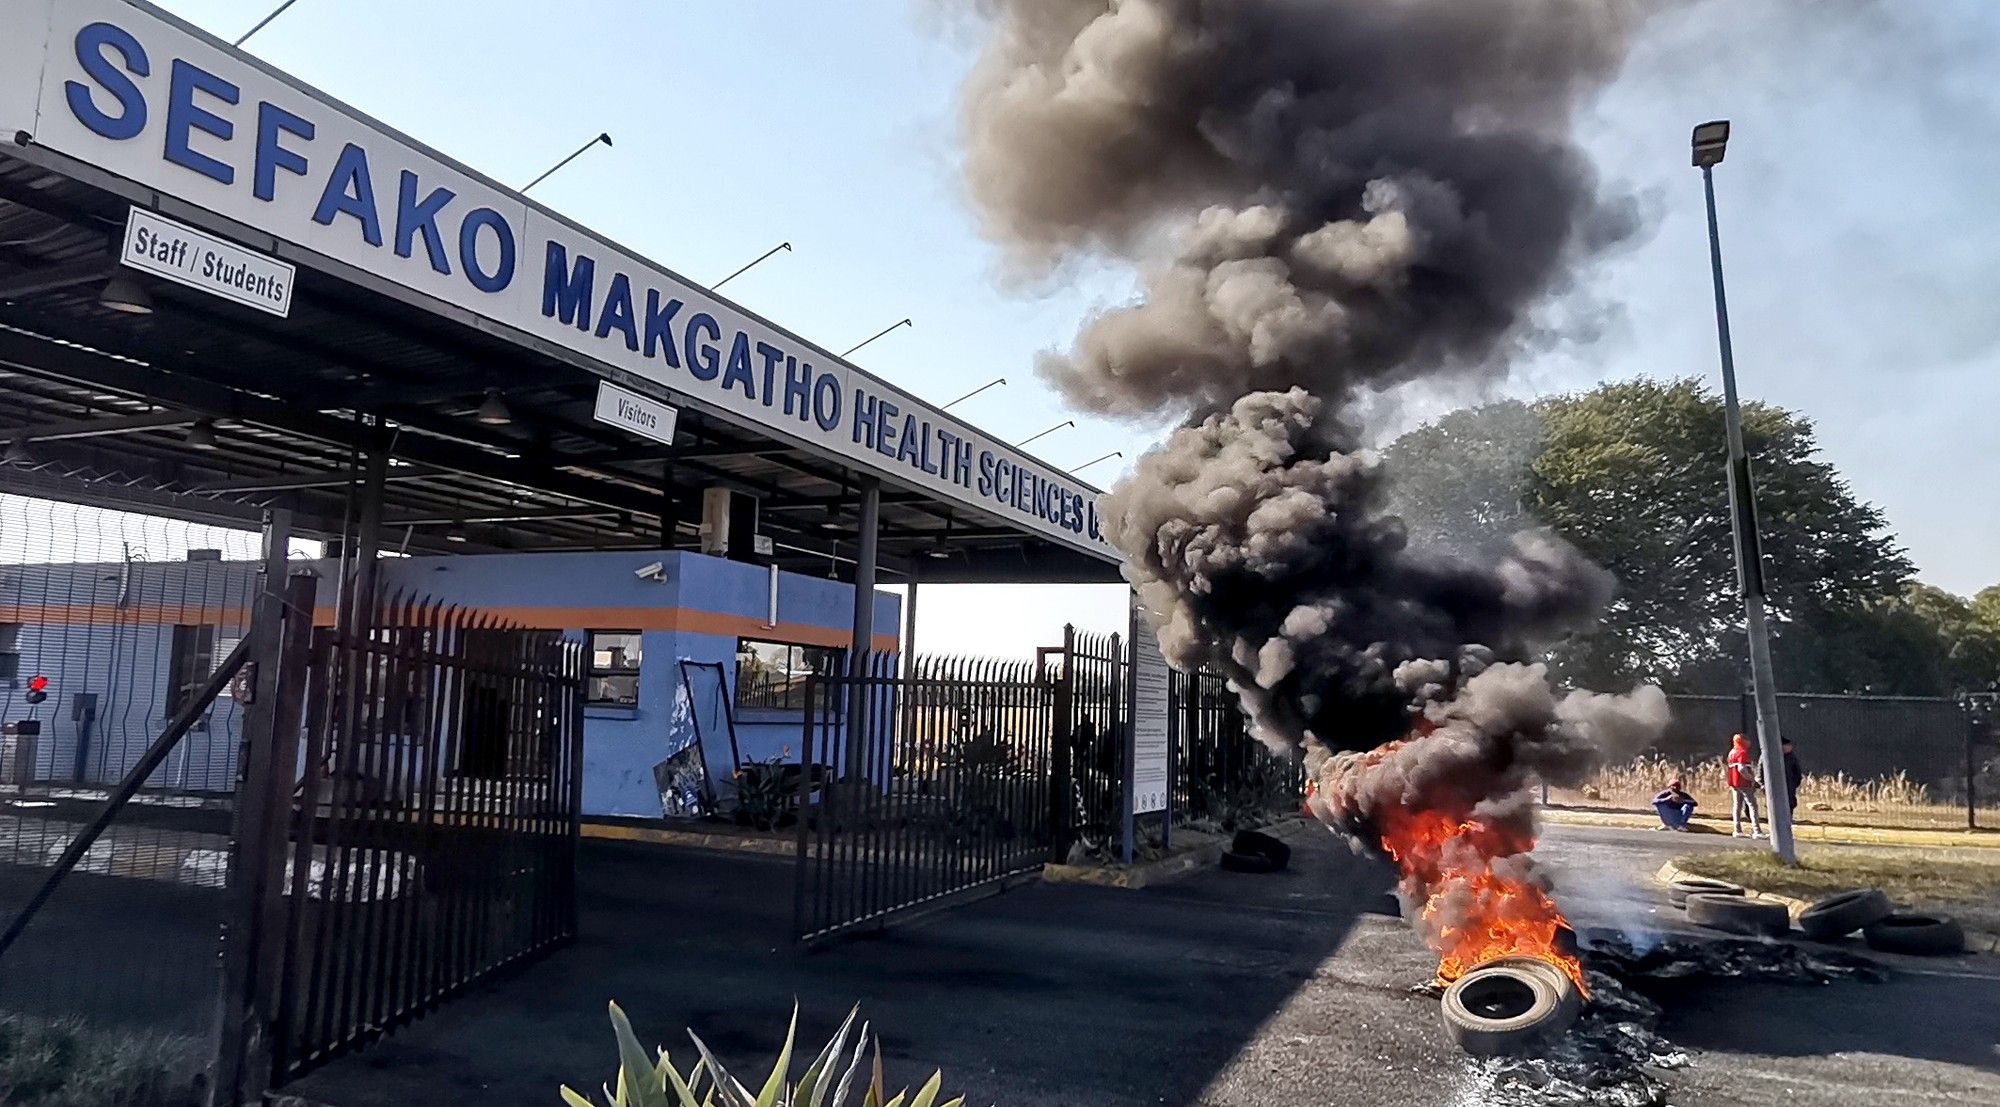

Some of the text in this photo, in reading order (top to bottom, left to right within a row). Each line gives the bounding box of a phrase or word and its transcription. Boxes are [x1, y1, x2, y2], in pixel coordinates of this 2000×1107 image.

[65, 22, 516, 293] SEFAKO
[541, 240, 842, 432] MAKGATHO
[852, 388, 973, 488] HEALTH
[978, 450, 1084, 534] SCIENCES
[135, 226, 189, 268] Staff
[203, 251, 284, 303] Students
[618, 398, 657, 429] Visitors
